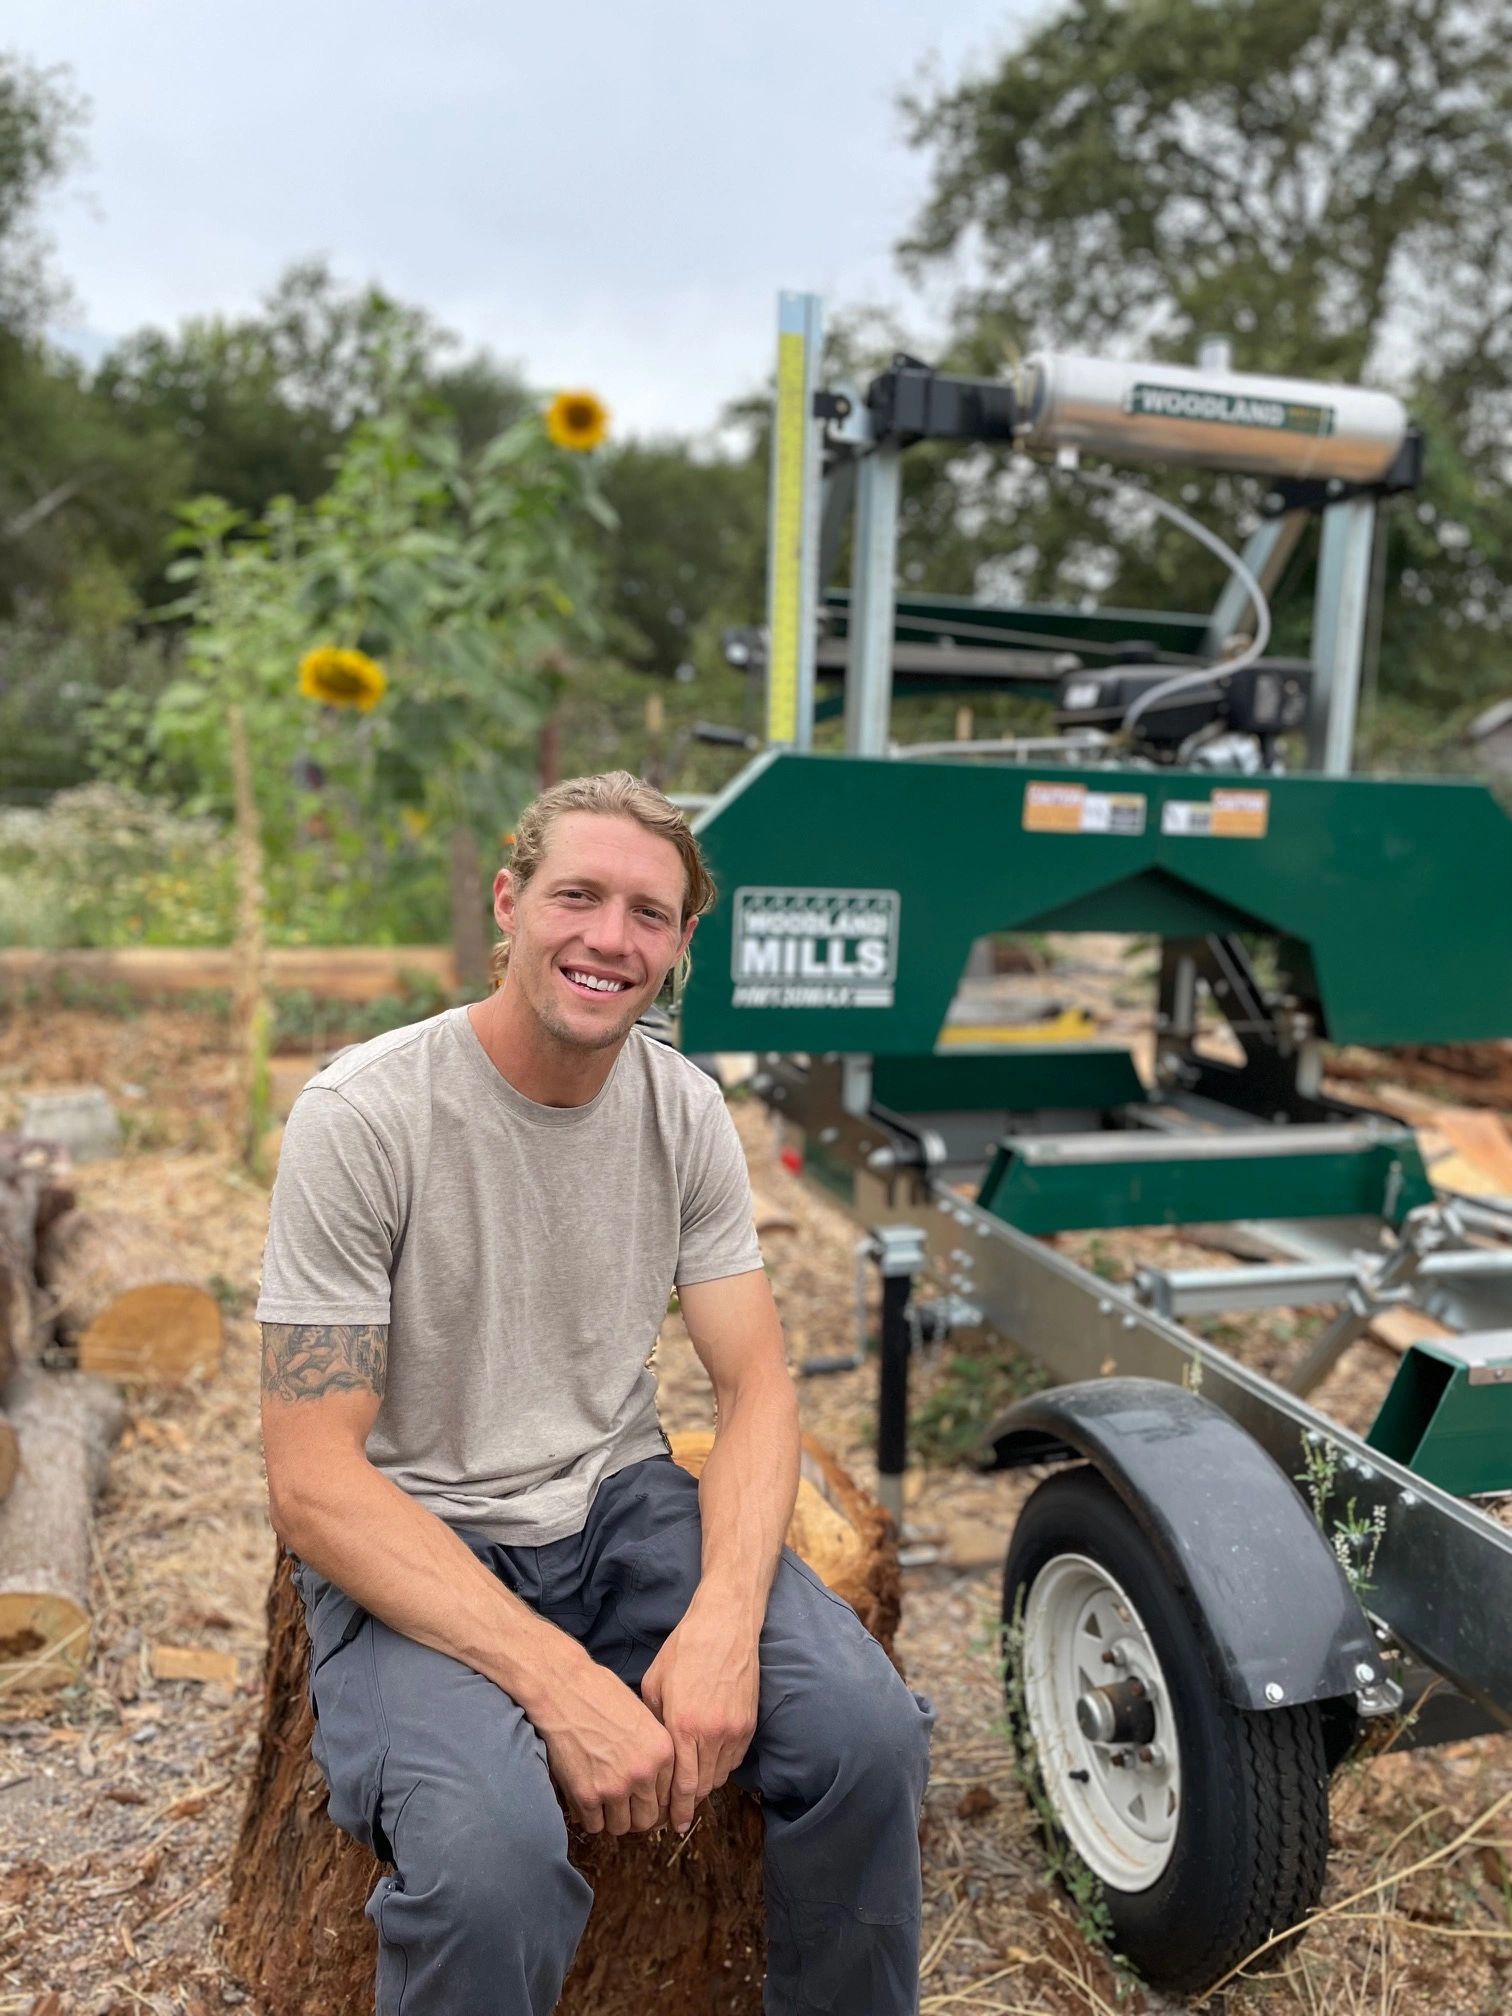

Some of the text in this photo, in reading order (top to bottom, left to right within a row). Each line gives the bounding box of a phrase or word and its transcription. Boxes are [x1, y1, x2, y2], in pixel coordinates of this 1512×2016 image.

[1139, 387, 1286, 427] WOODLAND
[744, 910, 889, 936] WOODLAND
[742, 936, 887, 979] MILLS
